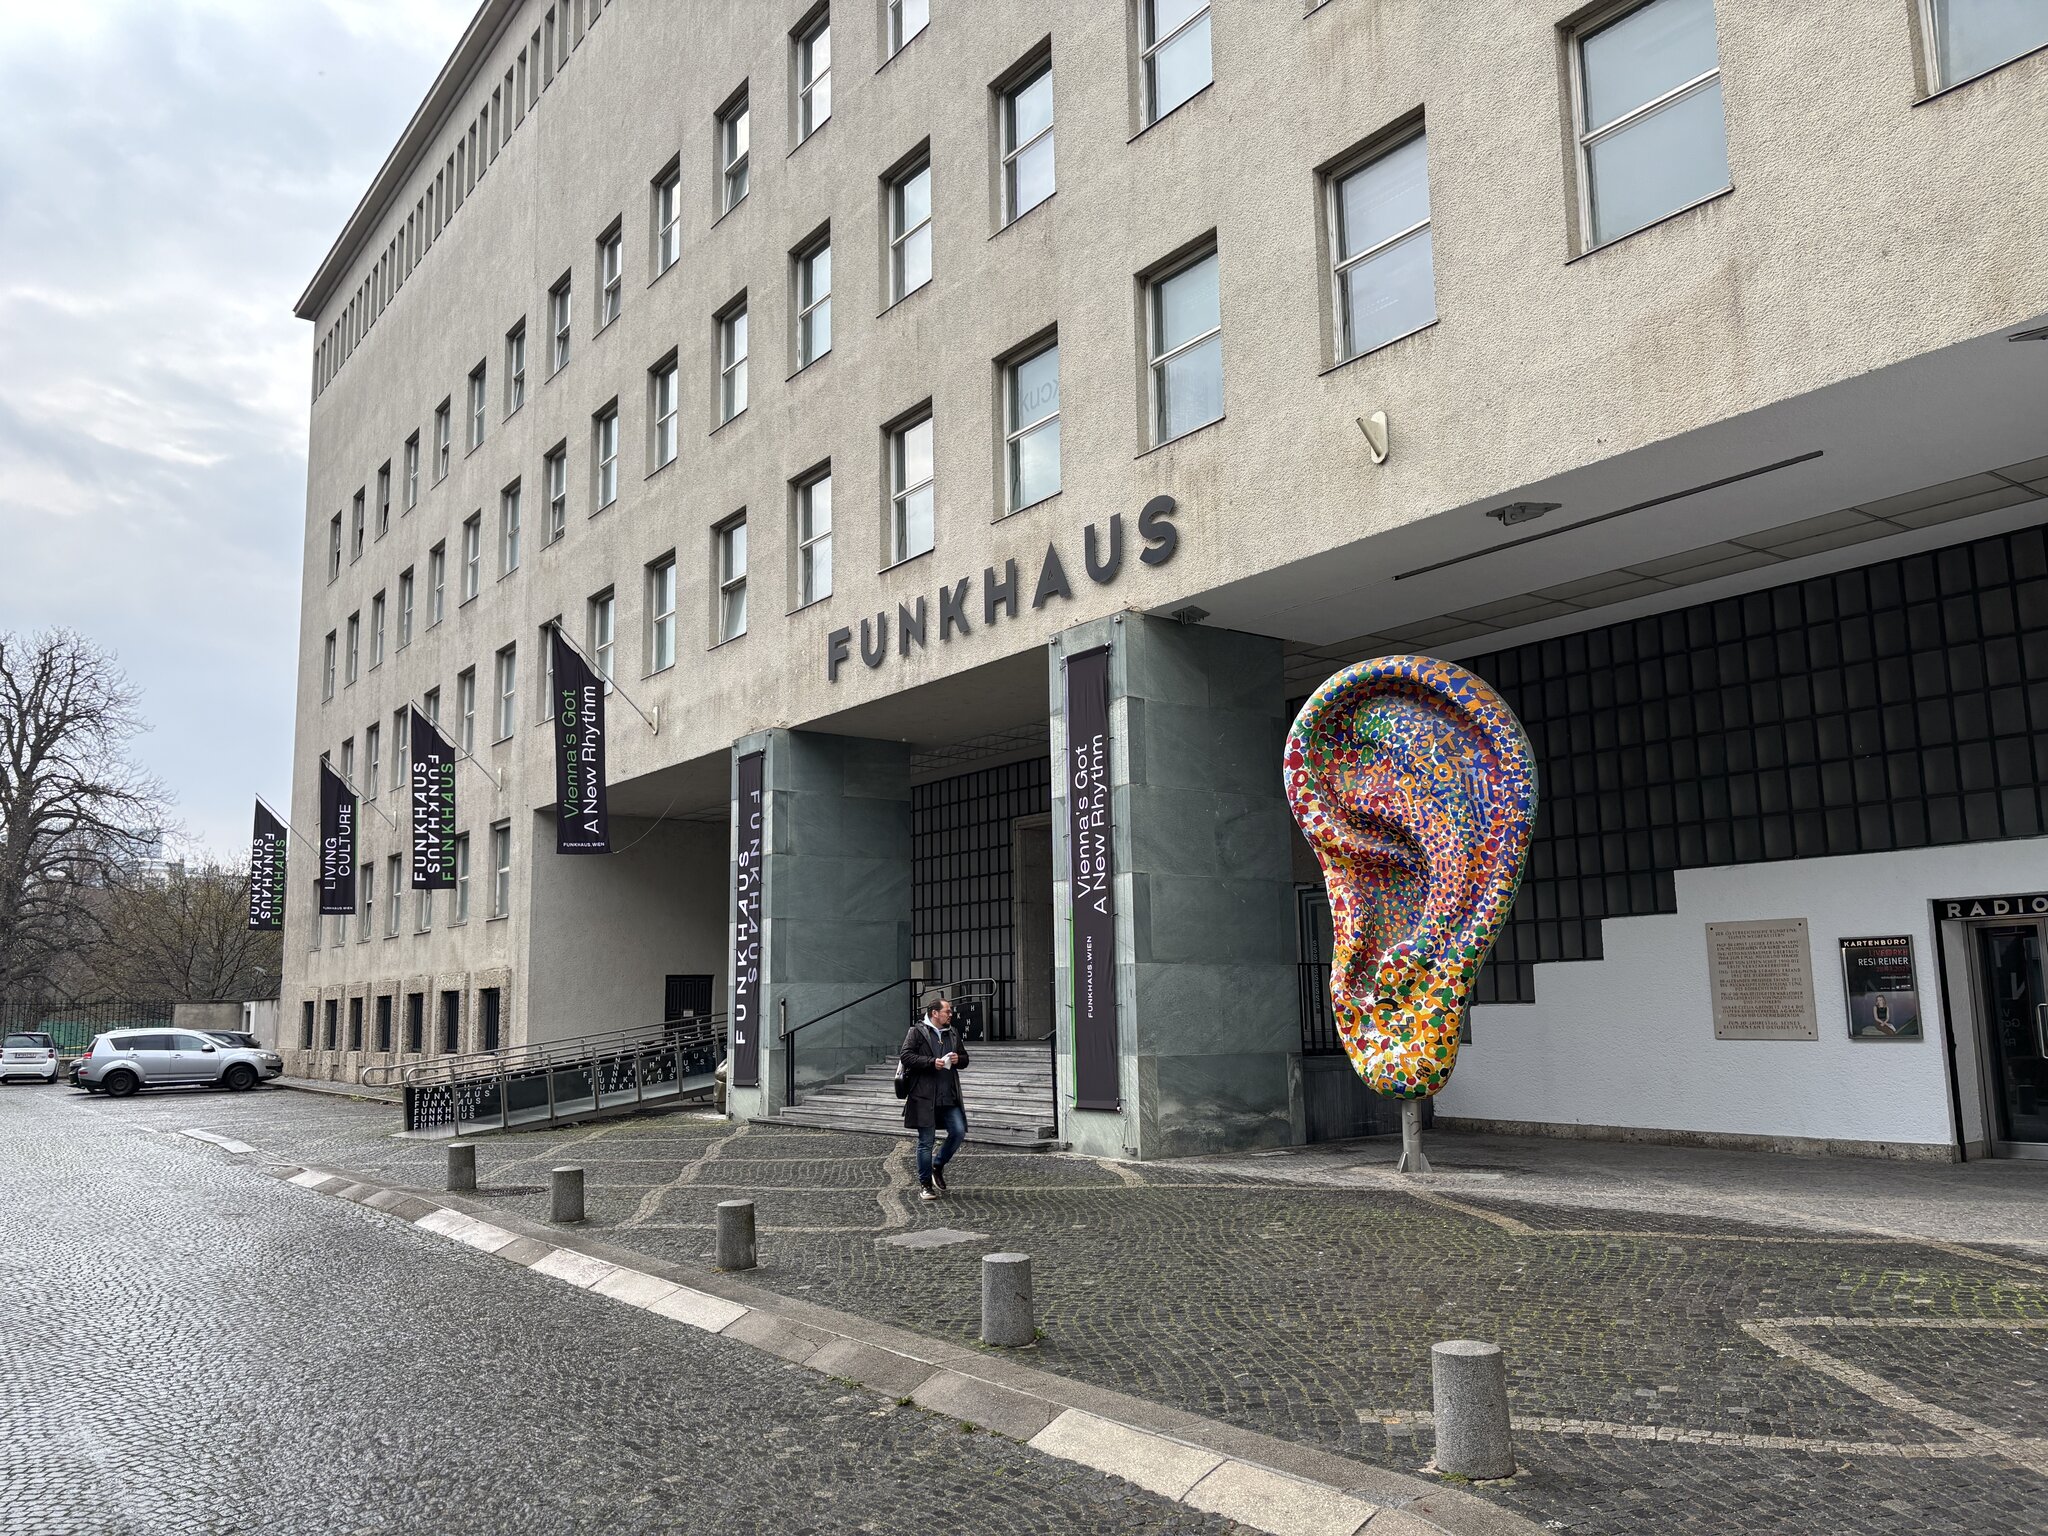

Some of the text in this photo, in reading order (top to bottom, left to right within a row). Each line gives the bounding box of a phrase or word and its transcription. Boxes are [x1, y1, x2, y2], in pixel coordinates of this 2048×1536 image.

[828, 494, 1178, 682] FUNKHAUS
[562, 690, 579, 818] Vienna's Got
[581, 686, 600, 834] A New Rhythm
[324, 838, 337, 889] LIVING
[338, 804, 351, 876] CULTURE
[414, 762, 427, 881] FUNKHAUS
[428, 754, 440, 873] FUNKHAUS
[441, 763, 454, 881] FUNKHAUS
[1075, 744, 1090, 898] Vienna's Got
[1090, 734, 1108, 914] A New Rhythm
[250, 838, 264, 925] FUNKHAUS
[260, 833, 274, 919] FUNKHAUS
[271, 839, 285, 925] FUNKHAUS
[747, 790, 760, 982] FUNKHAUS
[1947, 897, 2048, 917] RADIO
[736, 850, 750, 1044] FUNKHAUS
[1086, 936, 1094, 1018] FUNKHAUS.WIEN
[1858, 957, 1908, 966] RESI REINER
[414, 1105, 475, 1115] FUNKHUS
[414, 1112, 475, 1122] FUNKHUS
